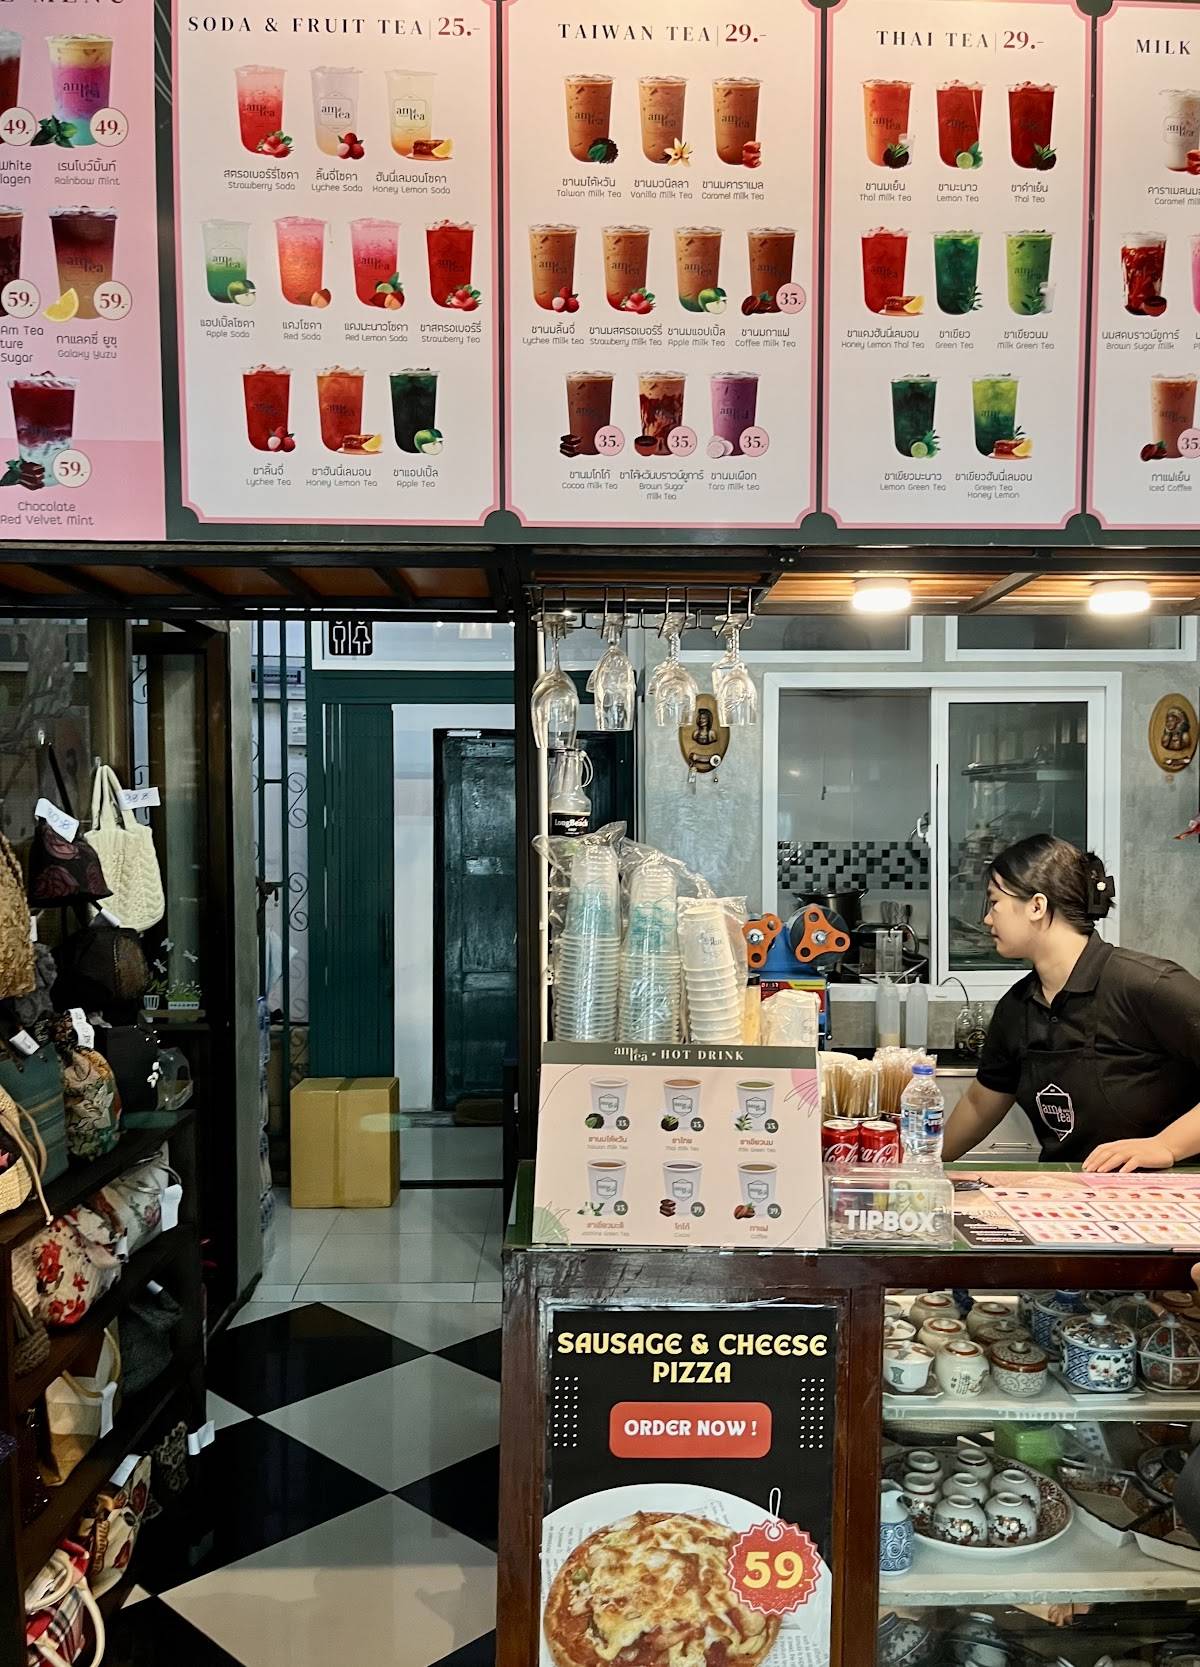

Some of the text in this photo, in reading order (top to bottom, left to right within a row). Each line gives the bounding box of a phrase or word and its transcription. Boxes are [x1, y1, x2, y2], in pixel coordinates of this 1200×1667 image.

[188, 17, 250, 31] SODA
[265, 18, 278, 32] &
[293, 18, 364, 33] FRUIT
[378, 20, 423, 34] TEA
[558, 24, 652, 40] TAIWAN
[667, 26, 710, 41] TEA
[876, 31, 932, 46] THAI
[946, 33, 988, 47] TEA
[1137, 40, 1190, 55] MILK
[54, 176, 120, 186] Rainbow Mint
[228, 181, 295, 191] Strawberry Soda
[312, 183, 363, 193] Lychee Soda
[372, 185, 450, 195] Honey Lemon Soda
[557, 188, 585, 198] Taiwan
[608, 190, 621, 199] Tea
[631, 190, 656, 199] Vanilla
[679, 191, 692, 200] Tea
[702, 191, 731, 201] Caramel
[751, 192, 764, 201] Tea
[860, 192, 875, 202] Thai
[898, 193, 912, 202] Tea
[937, 194, 979, 203] Lemon Tea
[1014, 194, 1045, 204] Thai Tea
[1, 326, 44, 335] Am Tea
[206, 330, 250, 340] Apple Soda
[283, 331, 321, 341] Red Soda
[345, 332, 408, 342] Red Lemon Soda
[422, 335, 480, 344] Strawberry Tea
[523, 336, 550, 346] Lychee
[571, 337, 584, 345] tea
[668, 338, 689, 347] Apple
[711, 338, 725, 348] Tea
[735, 338, 760, 348] Coffee
[783, 339, 796, 348] Tea
[841, 339, 925, 350] Honey Lemon Thai Tea
[935, 340, 974, 350] Green Tea
[1, 353, 33, 365] Sugar
[58, 350, 117, 360] Galaxy Yuzu
[246, 477, 291, 487] Lychee Tea
[305, 478, 377, 488] Honey Lemon Tea
[397, 479, 435, 488] Apple Tea
[880, 482, 946, 492] Lemon Green Tea
[974, 483, 1013, 492] Green Tea
[968, 490, 1020, 501] Honey Lemon
[18, 501, 76, 512] Chocolate
[0, 514, 94, 525] Red Velvet Mint
[661, 1050, 691, 1060] HOT
[697, 1050, 744, 1061] DRINK
[844, 1209, 936, 1233] TIPBOX
[557, 1332, 828, 1356] SAUSAGE & CHEESE
[652, 1361, 732, 1384] PIZZA
[624, 1419, 692, 1436] ORDER
[697, 1420, 746, 1436] NOW
